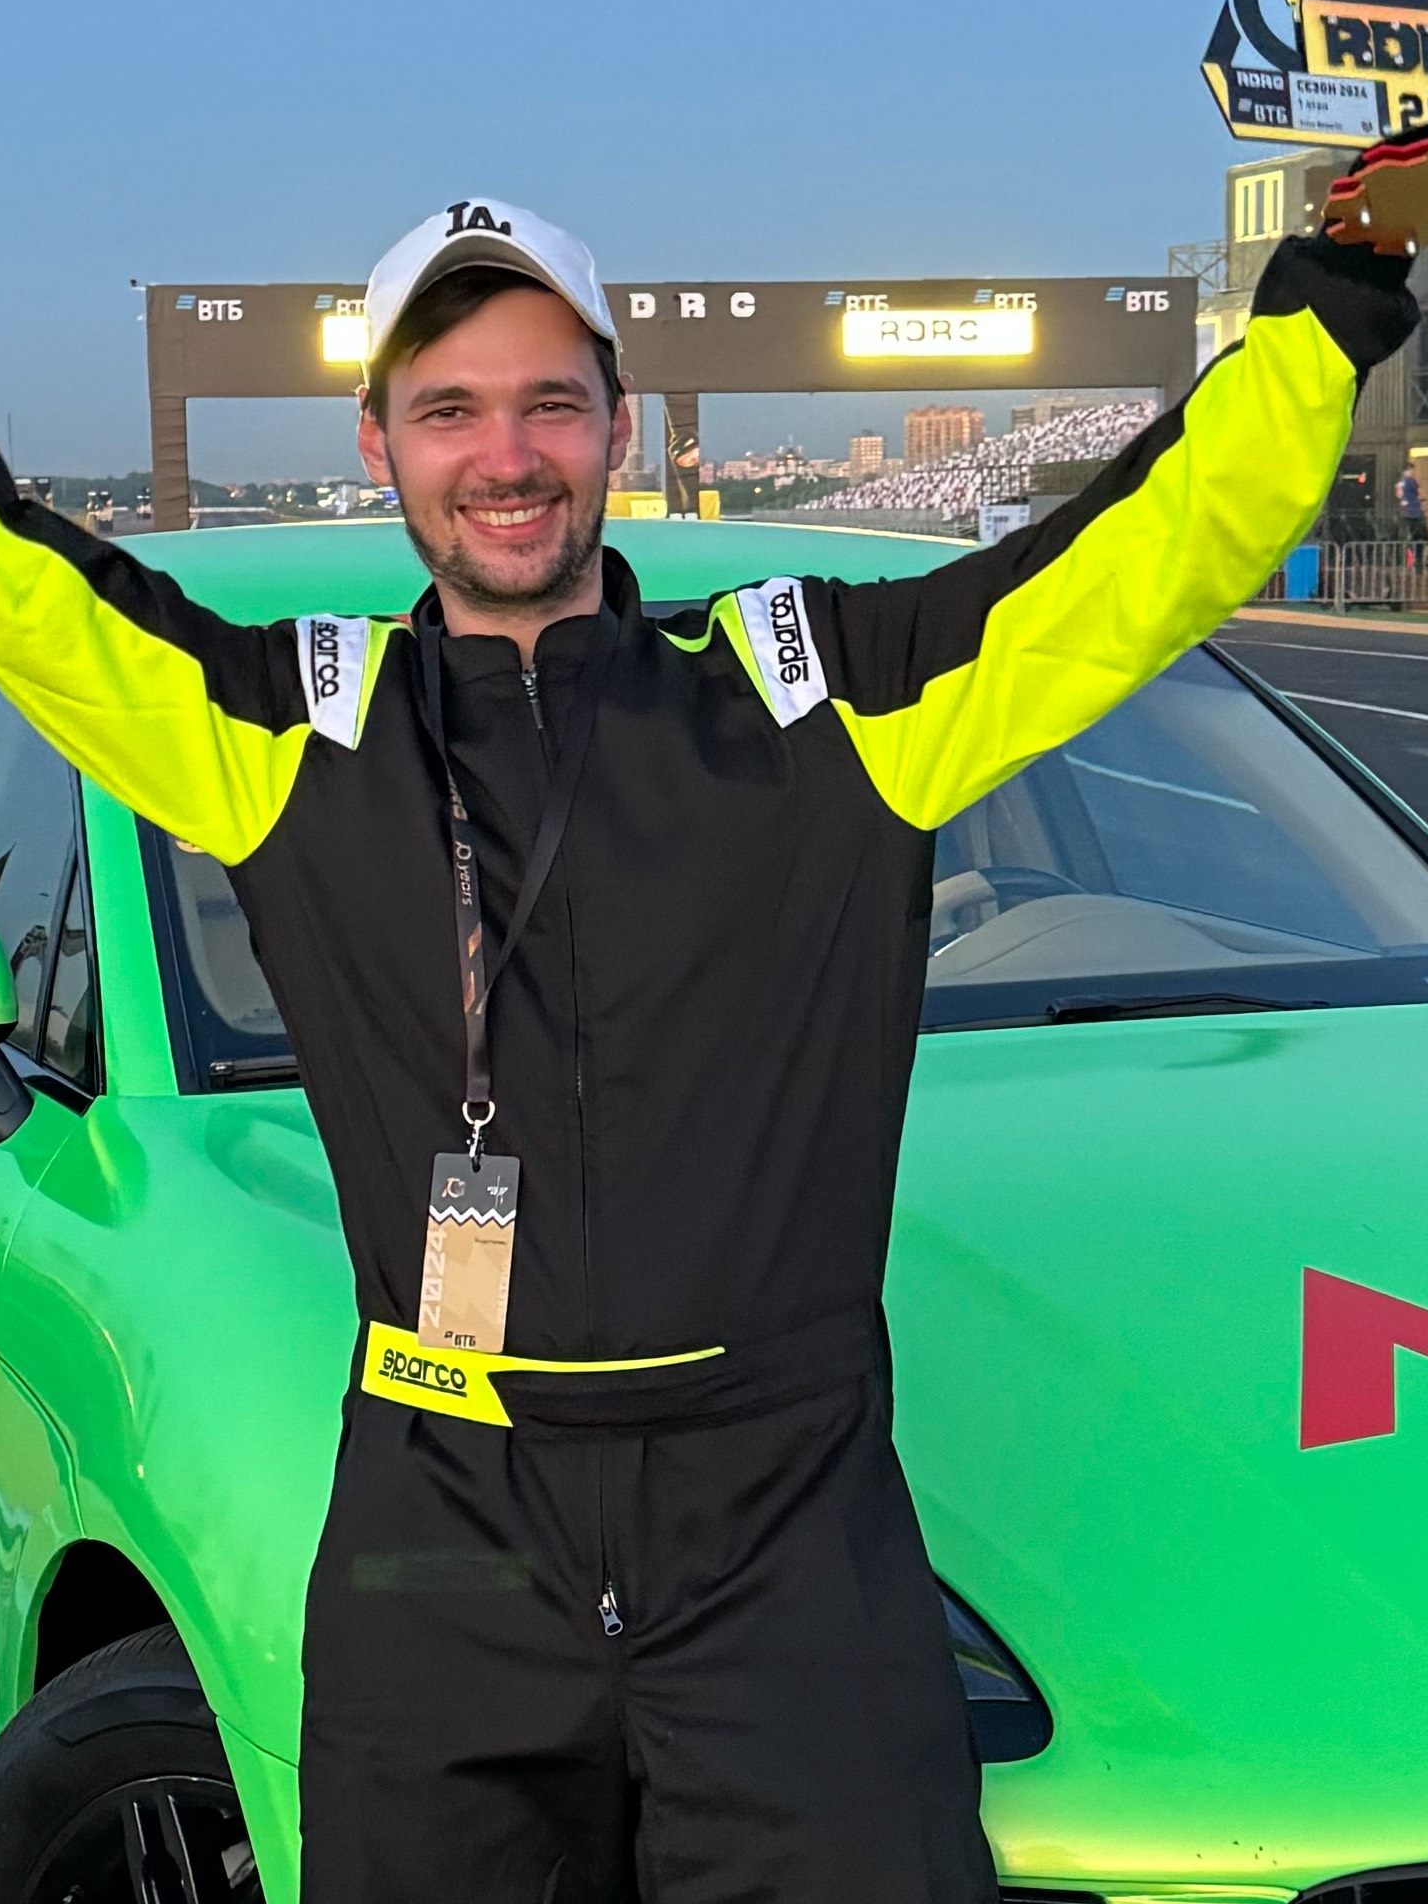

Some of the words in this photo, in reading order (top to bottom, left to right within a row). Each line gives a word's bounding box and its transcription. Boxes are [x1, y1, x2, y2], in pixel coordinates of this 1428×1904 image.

[445, 201, 512, 238] LA
[198, 299, 243, 322] ВТБ
[1125, 290, 1170, 312] ВТБ
[769, 591, 810, 684] sparco
[382, 1348, 467, 1392] sparco
